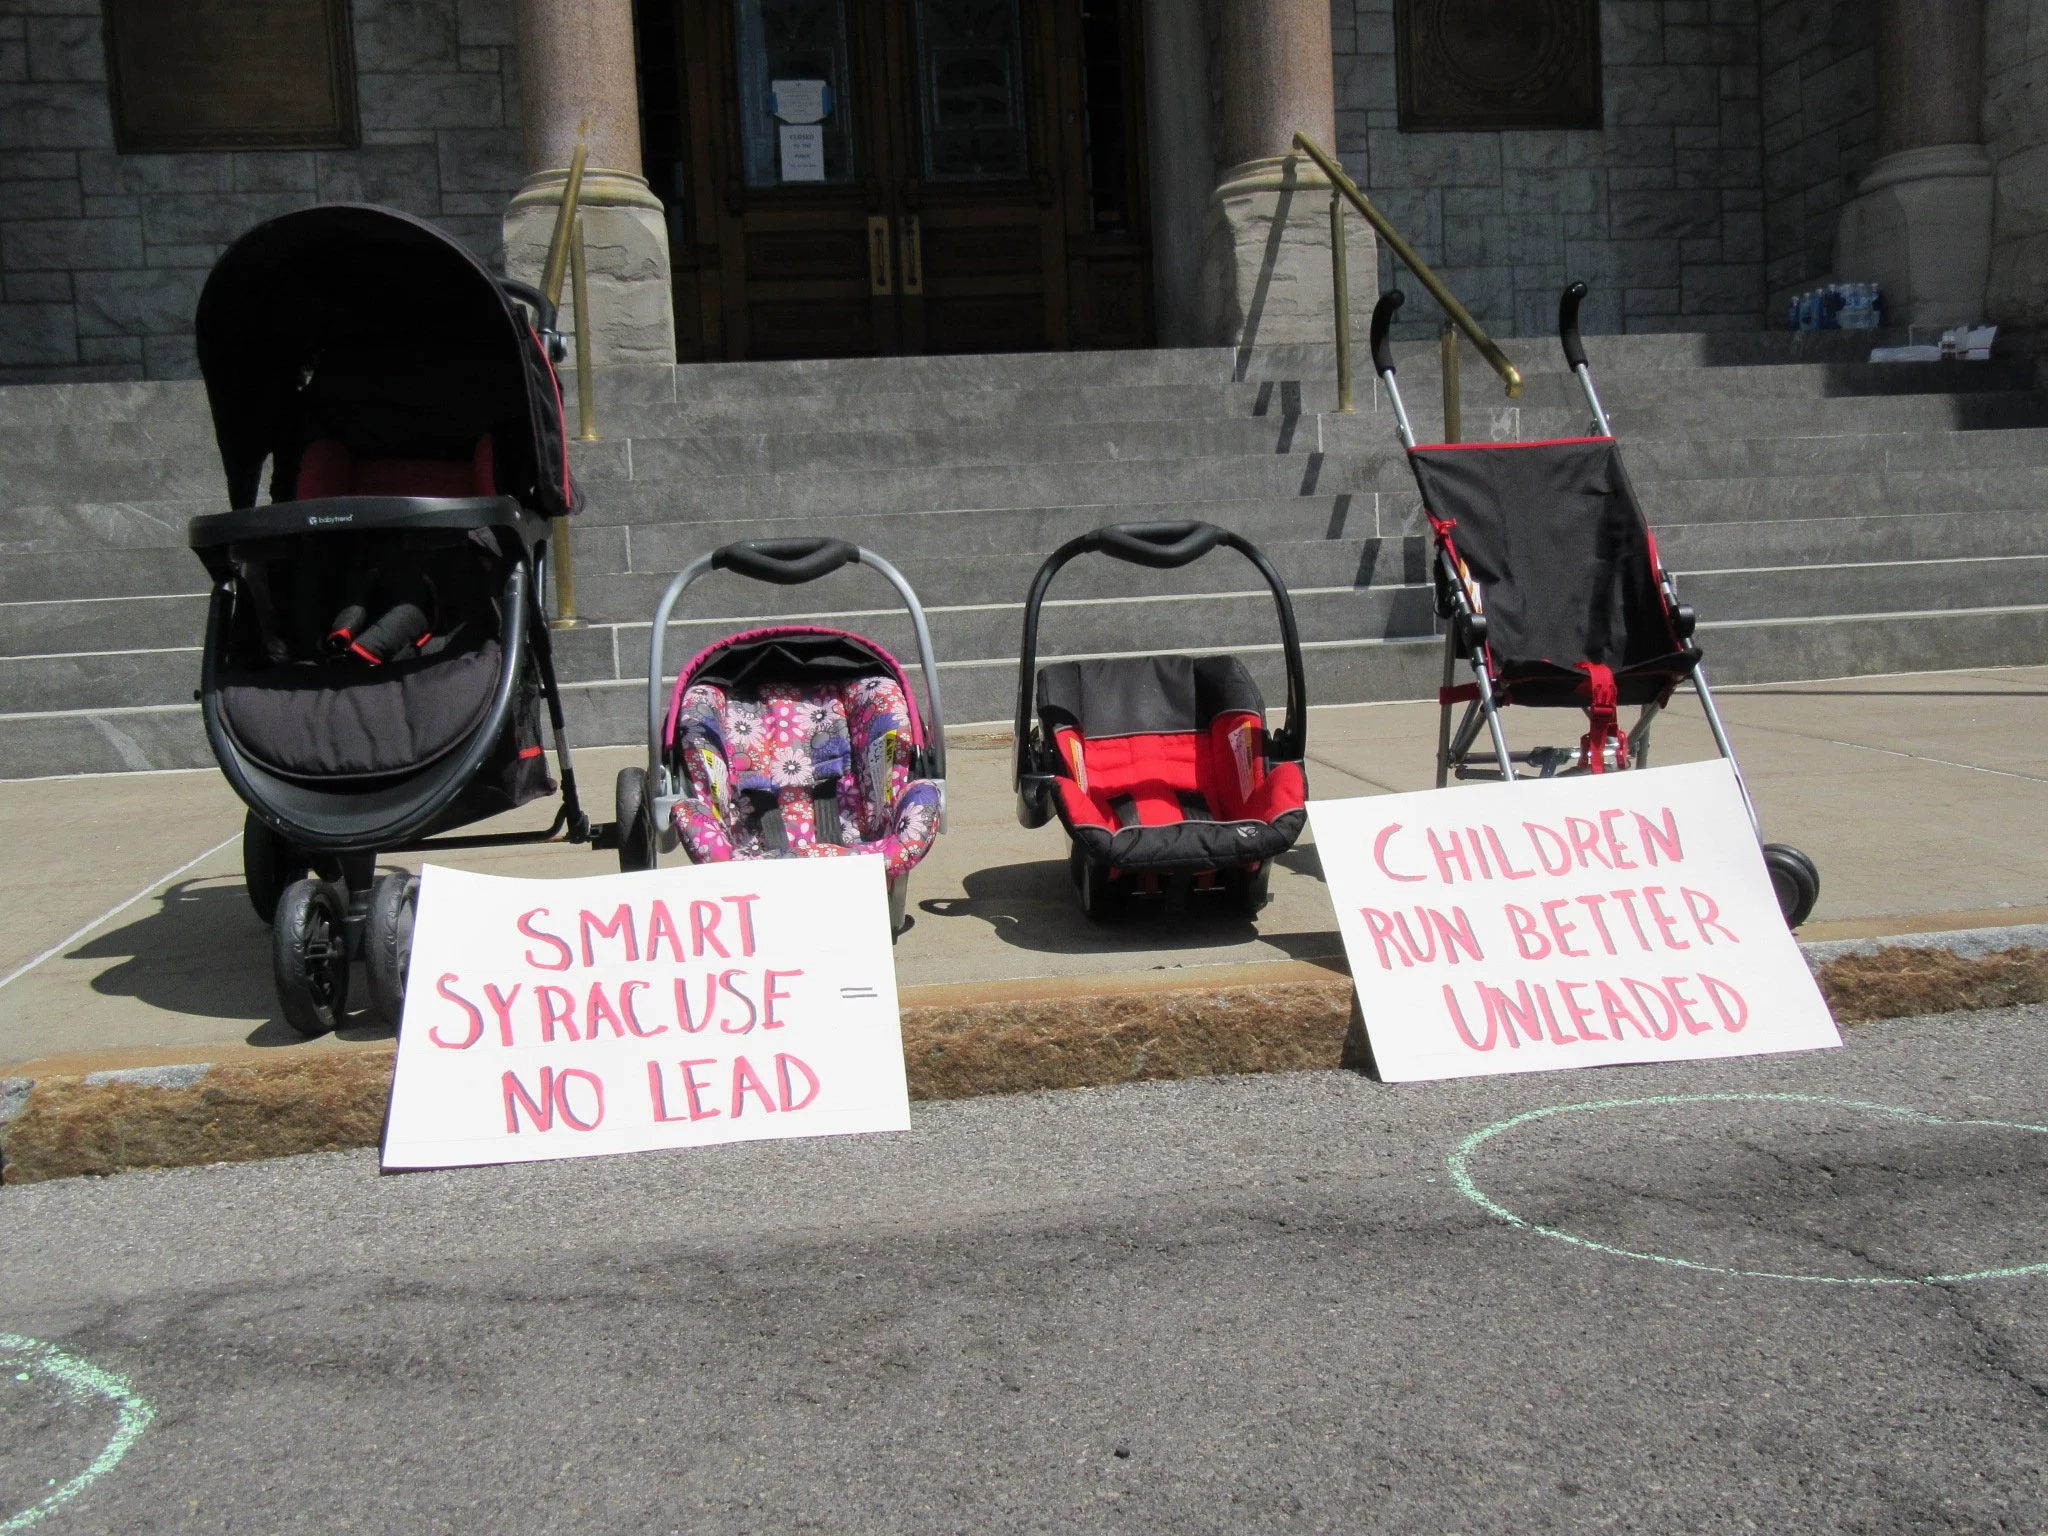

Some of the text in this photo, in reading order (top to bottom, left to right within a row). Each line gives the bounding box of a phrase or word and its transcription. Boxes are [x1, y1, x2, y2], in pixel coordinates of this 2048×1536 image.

[1373, 807, 1684, 885] CHILDREN
[517, 893, 761, 971] SMART
[1359, 886, 1740, 970] RUN BETTER
[428, 968, 804, 1050] SYRACUSE
[1443, 972, 1749, 1052] UNLEADED
[501, 1052, 821, 1134] NO LEAD
